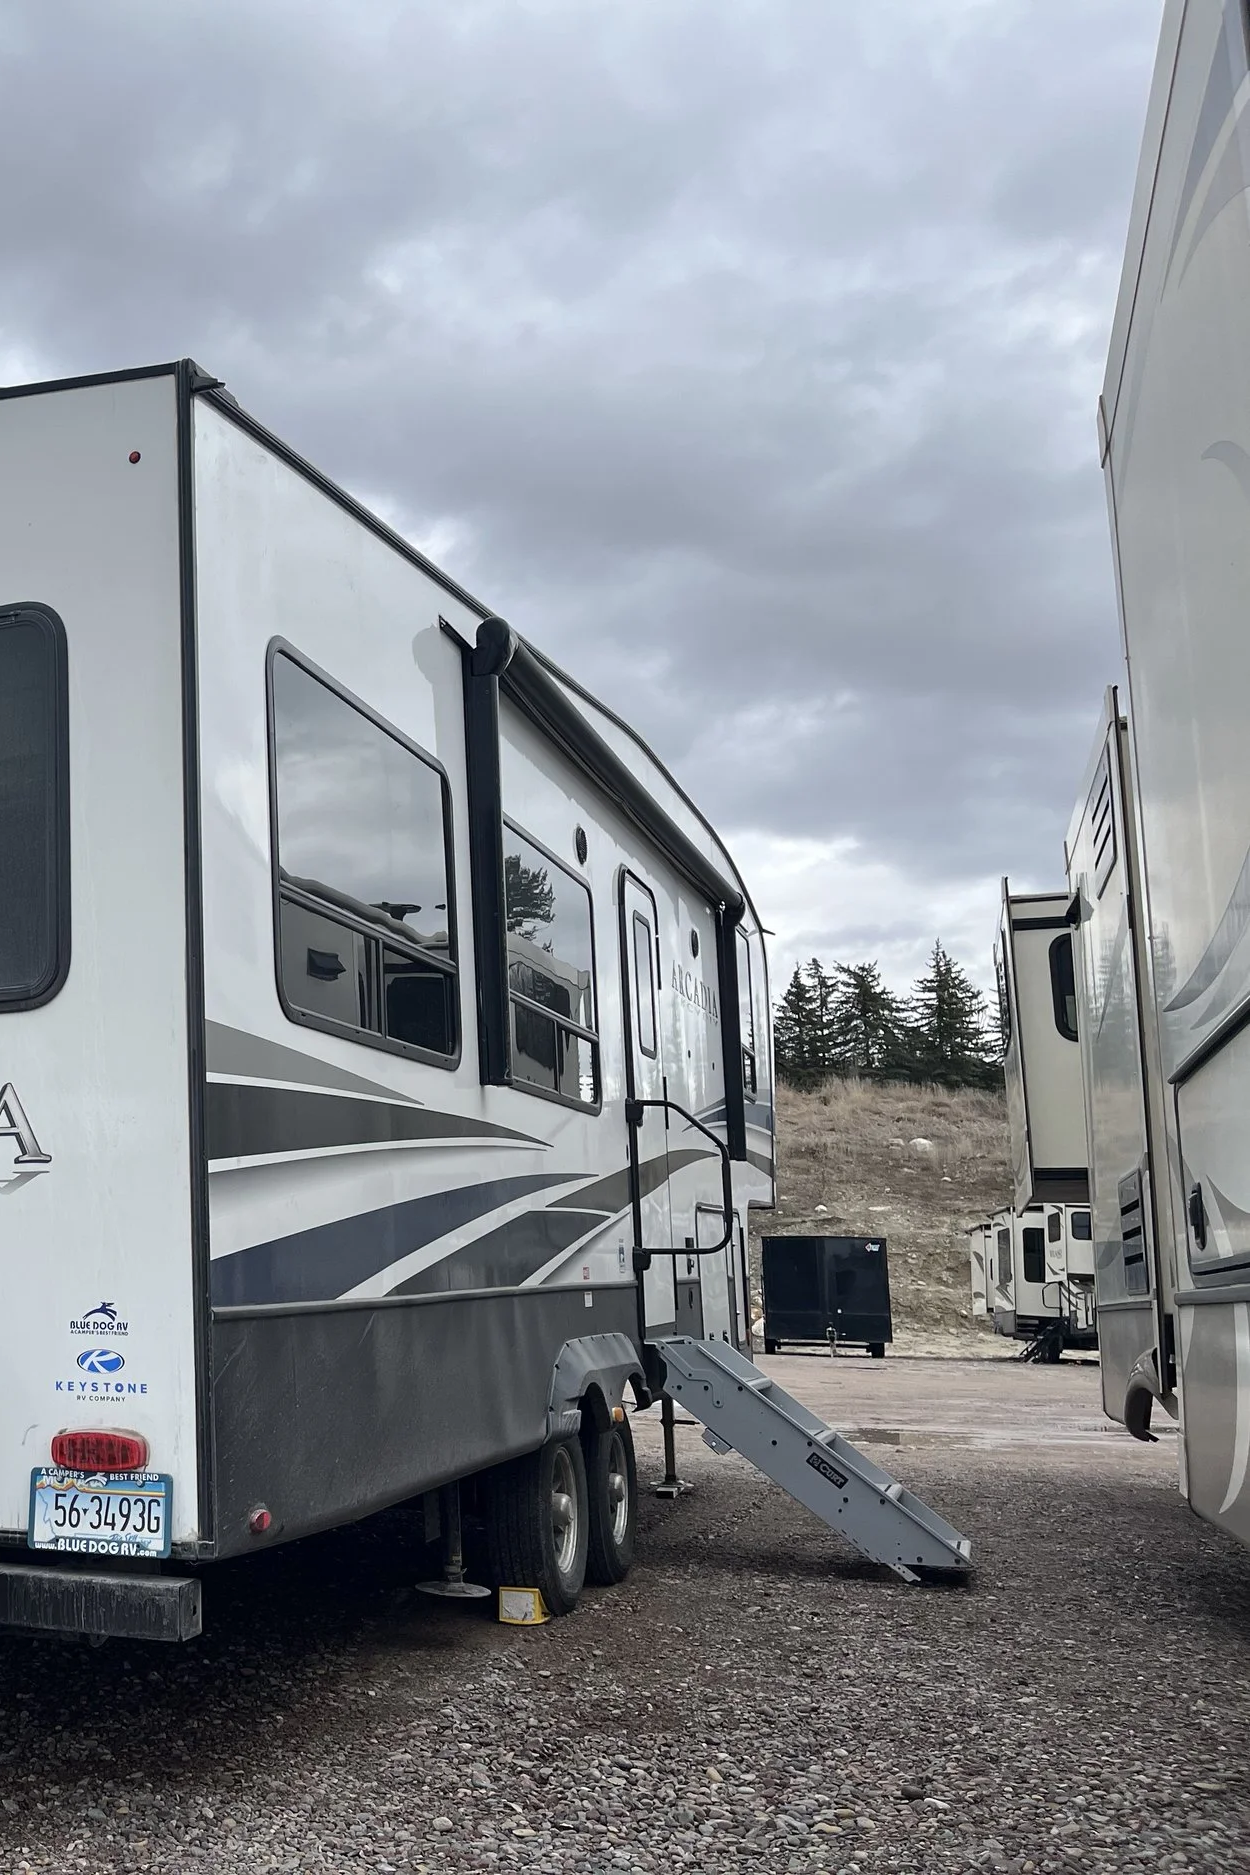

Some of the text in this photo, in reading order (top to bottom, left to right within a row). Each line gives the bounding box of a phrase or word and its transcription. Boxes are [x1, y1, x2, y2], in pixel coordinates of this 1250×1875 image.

[671, 959, 719, 1019] ARCADIA
[70, 1320, 128, 1331] BLUE DOG RV
[55, 1380, 148, 1394] KEYSTONE
[76, 1394, 126, 1403] RV COMPANY
[40, 1467, 47, 1476] A
[48, 1468, 85, 1479] CAMPER'S
[109, 1473, 129, 1481] BEST
[130, 1473, 160, 1482] FRIEND
[820, 1464, 845, 1485] CURT
